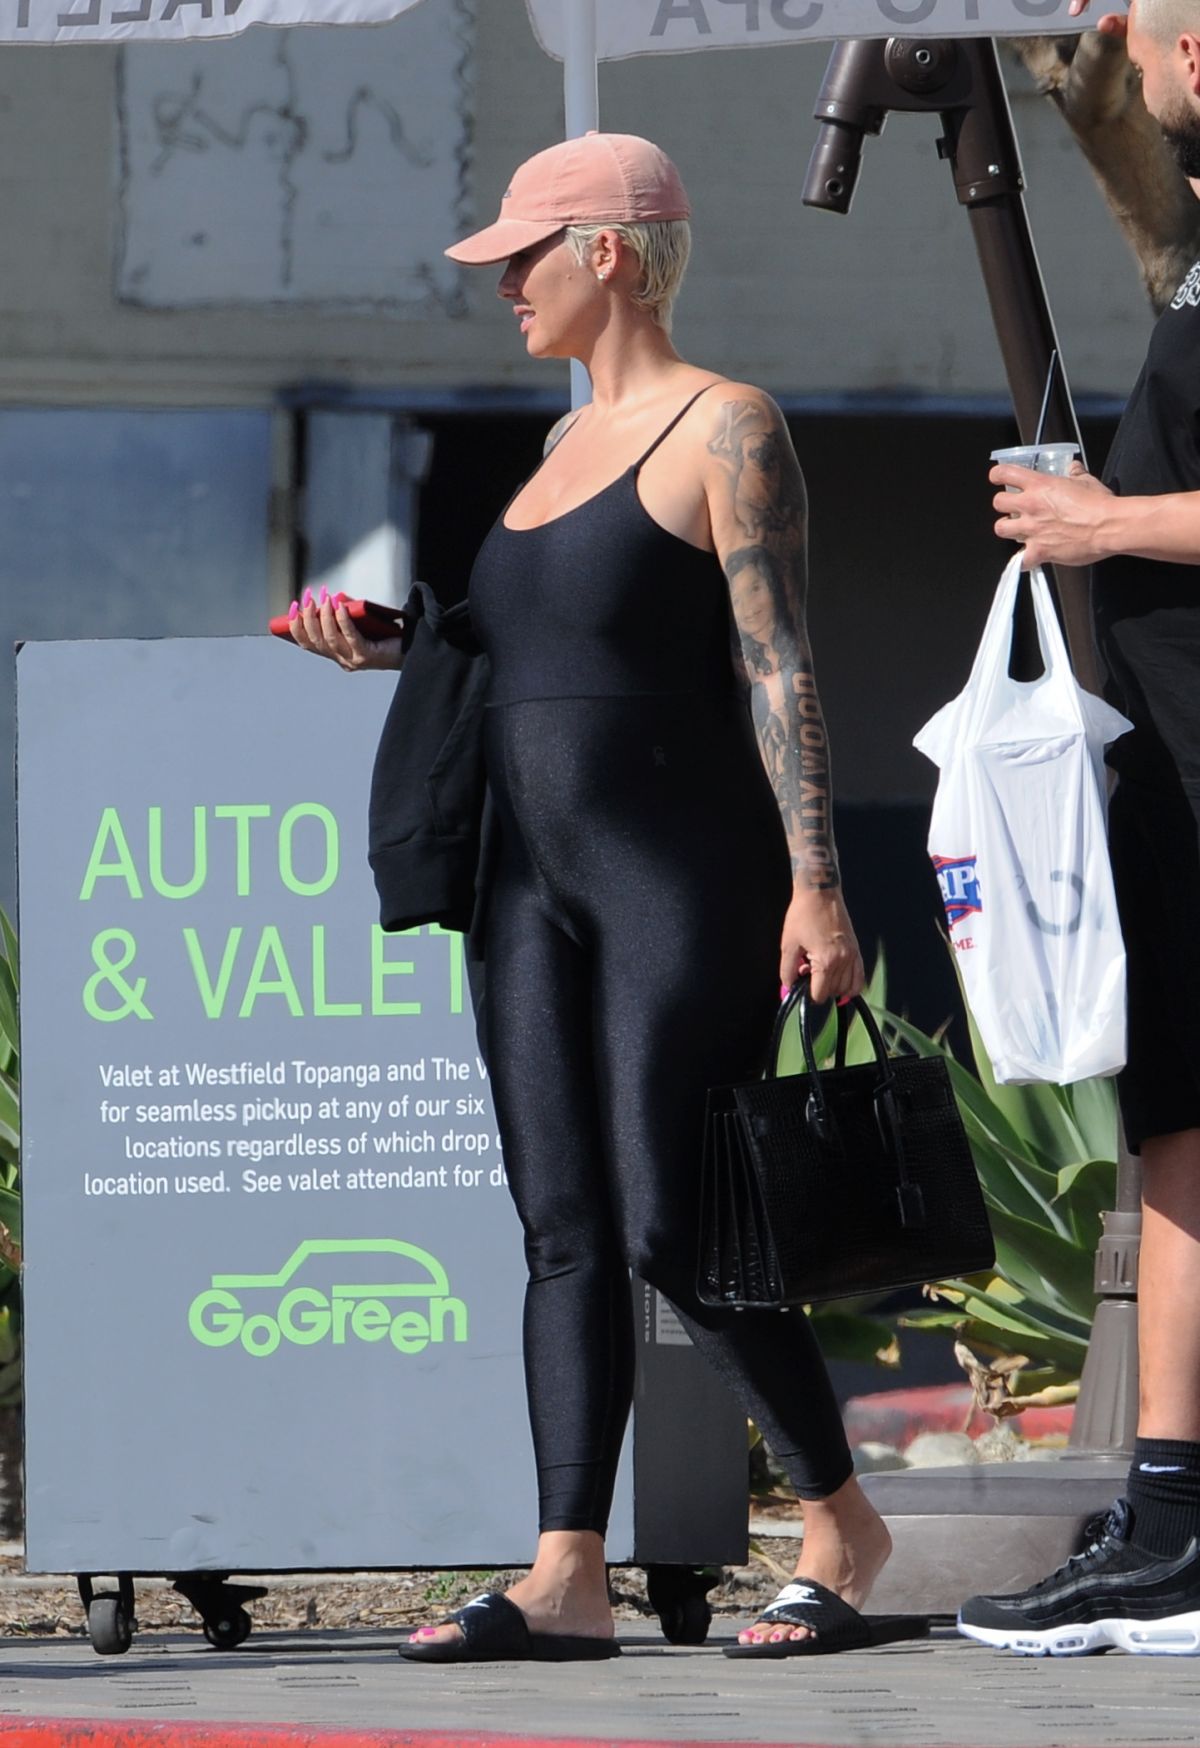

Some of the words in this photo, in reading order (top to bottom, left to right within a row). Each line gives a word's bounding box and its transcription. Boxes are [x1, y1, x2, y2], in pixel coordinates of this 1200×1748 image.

[792, 672, 837, 888] HOLLYWOOD
[80, 802, 339, 900] AUTO
[83, 928, 153, 1021] &
[183, 922, 464, 1019] VALET
[99, 1064, 153, 1089] Valet
[158, 1066, 180, 1087] at
[185, 1061, 286, 1086] Westfield
[291, 1060, 381, 1089] Topanga
[387, 1057, 425, 1083] and
[431, 1056, 470, 1081] The
[100, 1100, 130, 1123] for
[135, 1098, 237, 1123] seamless
[242, 1097, 313, 1127] pickup
[318, 1097, 340, 1119] at
[345, 1101, 383, 1124] any
[388, 1094, 409, 1118] of
[415, 1099, 450, 1117] our
[455, 1093, 485, 1116] six
[125, 1135, 222, 1159] locations
[227, 1132, 342, 1162] regardless
[347, 1131, 368, 1154] of
[372, 1129, 435, 1154] which
[441, 1128, 490, 1156] drop
[84, 1171, 168, 1196] location
[174, 1170, 231, 1194] used.
[242, 1169, 282, 1193] See
[287, 1168, 341, 1191] valet
[346, 1165, 448, 1190] attendant
[453, 1164, 484, 1187] for
[188, 1287, 467, 1357] GoGreen
